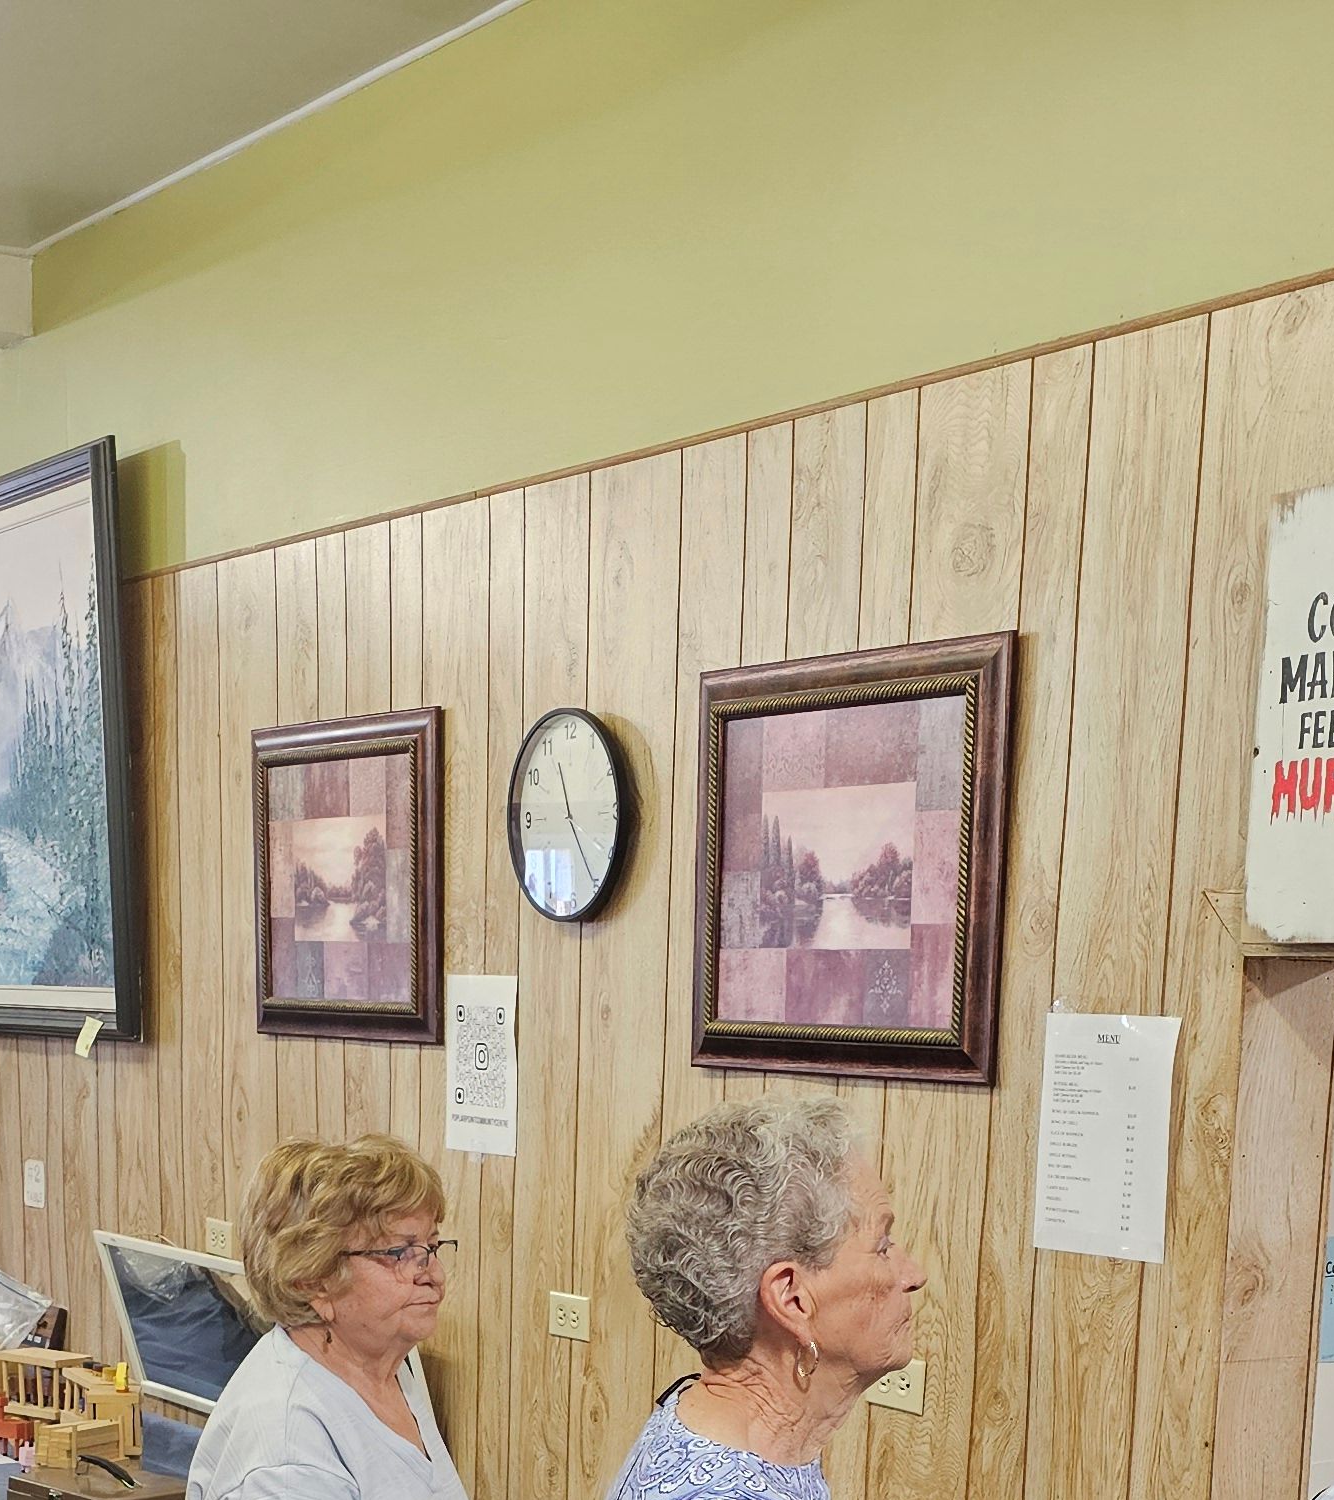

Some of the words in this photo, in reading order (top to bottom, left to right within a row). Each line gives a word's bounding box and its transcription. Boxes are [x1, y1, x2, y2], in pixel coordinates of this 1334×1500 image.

[564, 721, 577, 740] 12
[542, 738, 553, 756] 11
[528, 768, 540, 786] 10
[525, 811, 532, 829] 9
[1097, 1033, 1122, 1045] MENU
